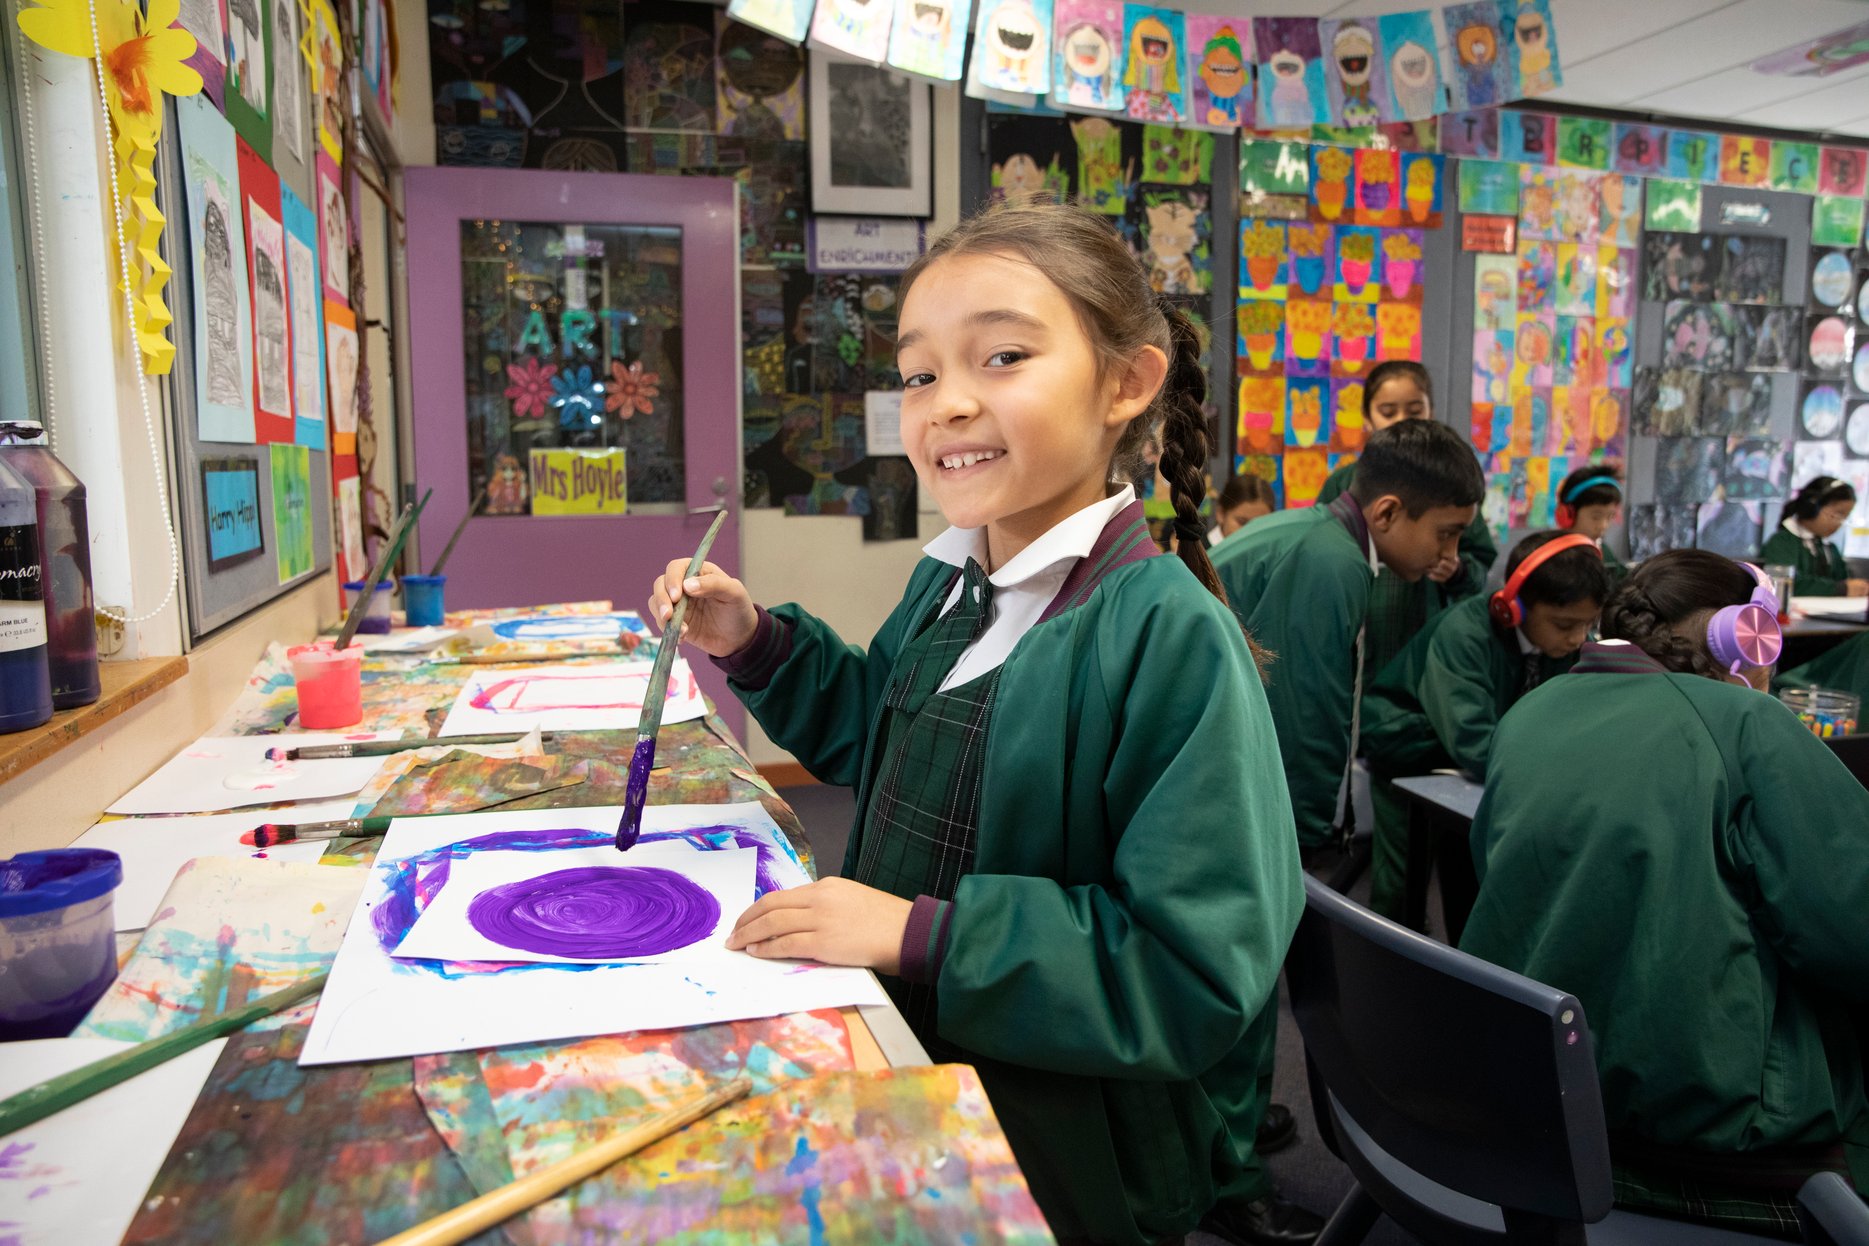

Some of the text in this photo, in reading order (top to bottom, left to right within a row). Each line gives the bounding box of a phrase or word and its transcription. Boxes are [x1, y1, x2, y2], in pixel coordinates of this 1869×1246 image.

[514, 310, 638, 357] ART
[532, 454, 625, 510] Mrs Hoyle
[210, 504, 236, 536] Harry
[13, 617, 28, 625] BLUE
